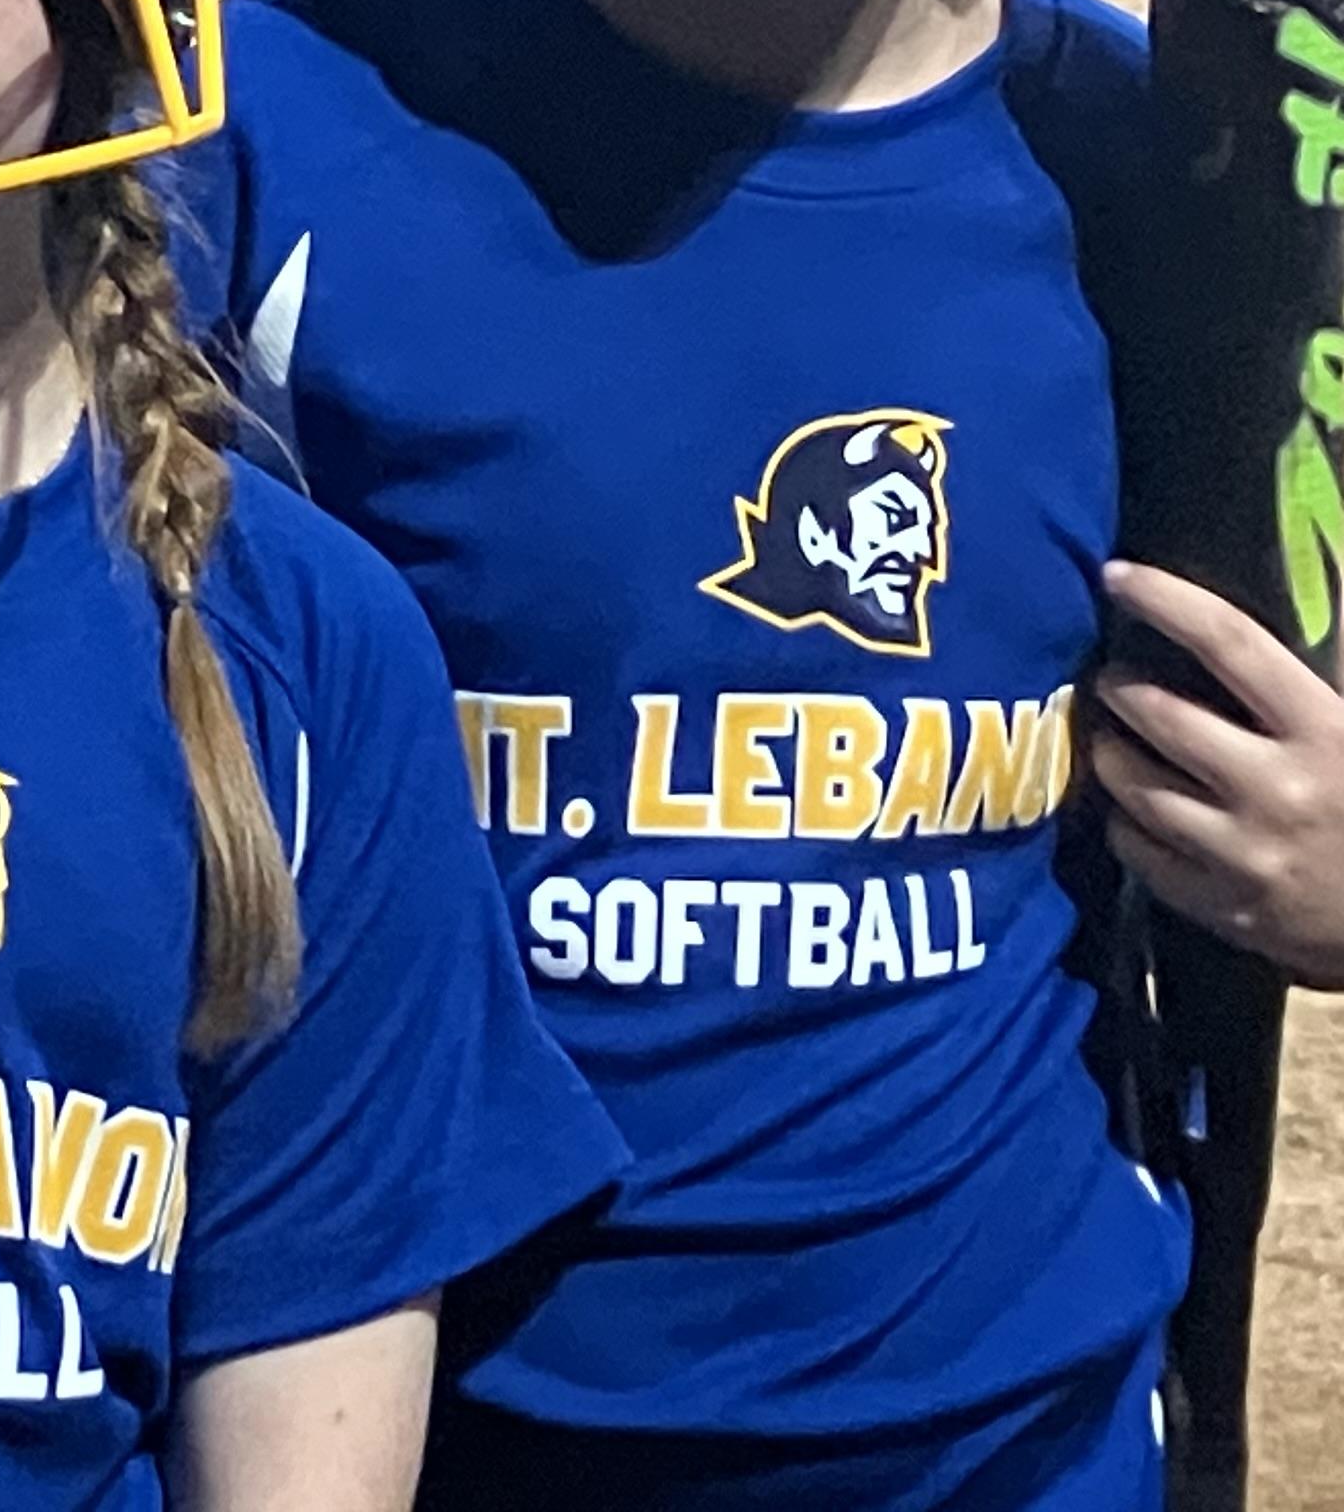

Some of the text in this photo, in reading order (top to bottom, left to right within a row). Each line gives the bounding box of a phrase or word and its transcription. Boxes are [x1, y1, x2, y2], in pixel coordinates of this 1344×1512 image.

[454, 684, 1074, 839] T. LEBANO
[529, 869, 985, 988] SOFTBALL
